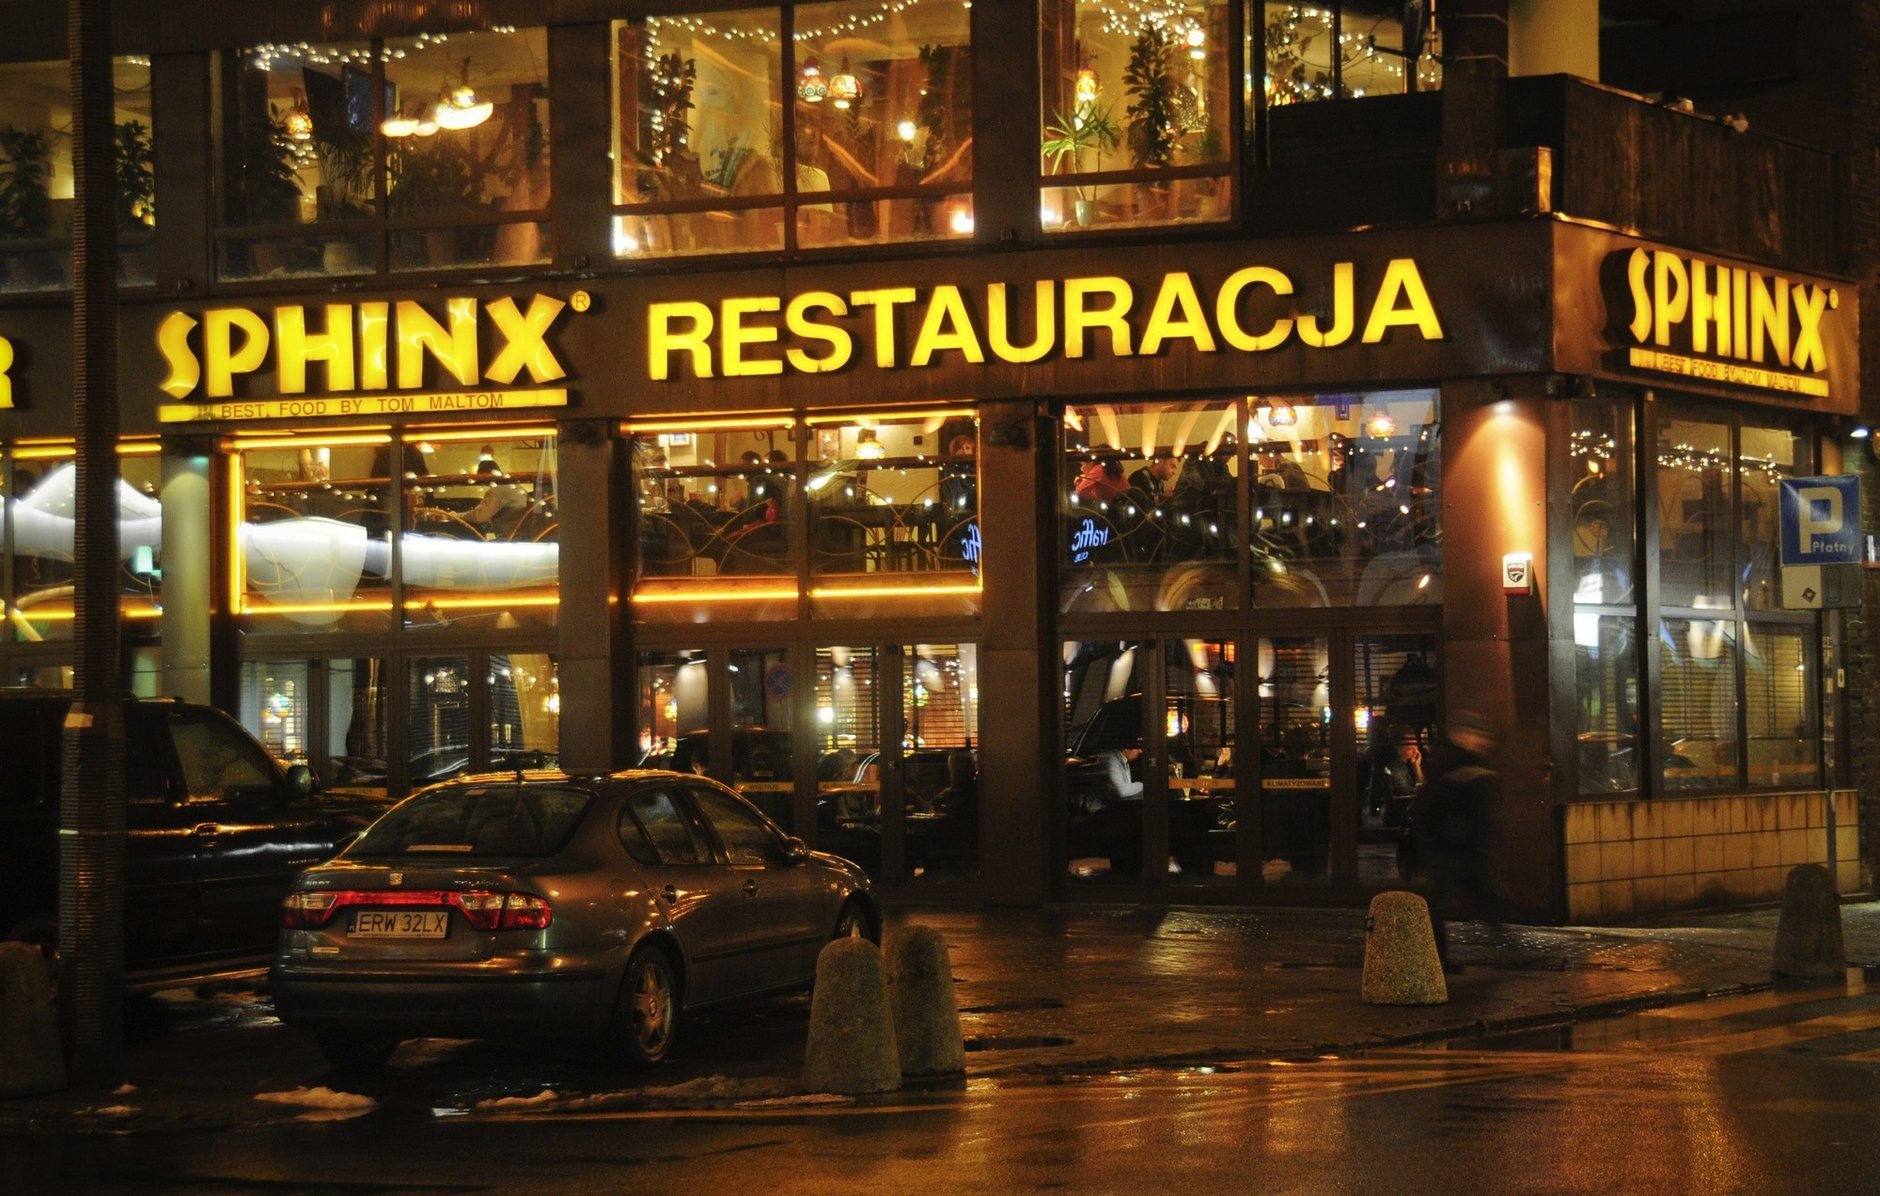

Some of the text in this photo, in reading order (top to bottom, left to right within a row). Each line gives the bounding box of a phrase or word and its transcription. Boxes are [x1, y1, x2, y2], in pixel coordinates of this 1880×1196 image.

[649, 258, 1444, 381] RESTAURACJA
[1629, 247, 1827, 372] SPHINX
[157, 293, 567, 399] SPHINX
[1662, 355, 1800, 391] BEST FOOD BY TOM MALTOM
[221, 393, 504, 419] BEST FOOD BY TOM MALTOM
[1798, 486, 1843, 554] P
[1812, 541, 1855, 555] Płatny
[358, 913, 446, 933] ERW 32LX
